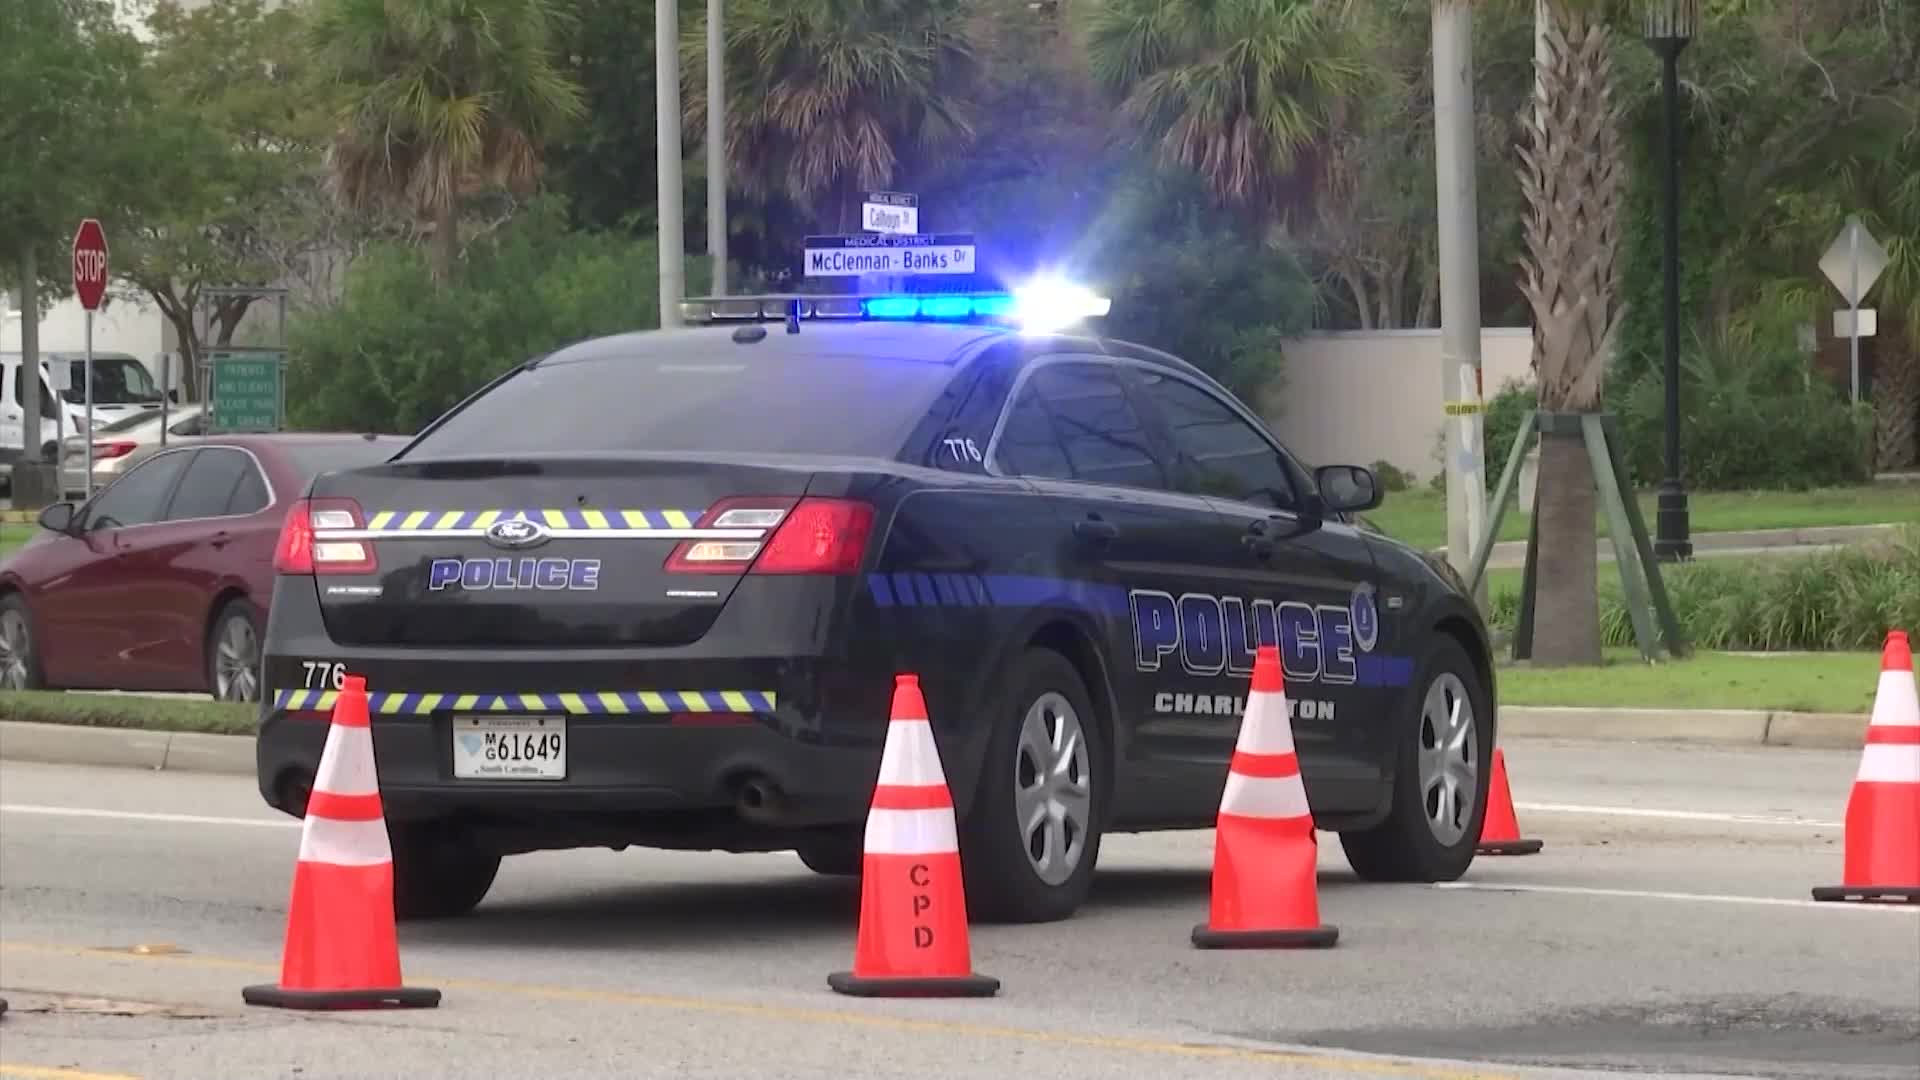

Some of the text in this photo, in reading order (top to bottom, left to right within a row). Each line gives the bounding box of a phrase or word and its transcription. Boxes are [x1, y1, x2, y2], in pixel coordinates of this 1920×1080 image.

[845, 234, 936, 247] MEDICAL DISTRICT
[76, 249, 105, 282] STOP
[812, 252, 890, 271] McClennan
[903, 250, 948, 269] Banks
[954, 249, 966, 262] Dr
[943, 438, 982, 462] 776
[498, 522, 530, 537] Ford
[428, 558, 601, 591] POLICE
[1130, 589, 1357, 684] POLICE
[302, 661, 347, 690] 776
[1154, 692, 1335, 721] CHARLTON
